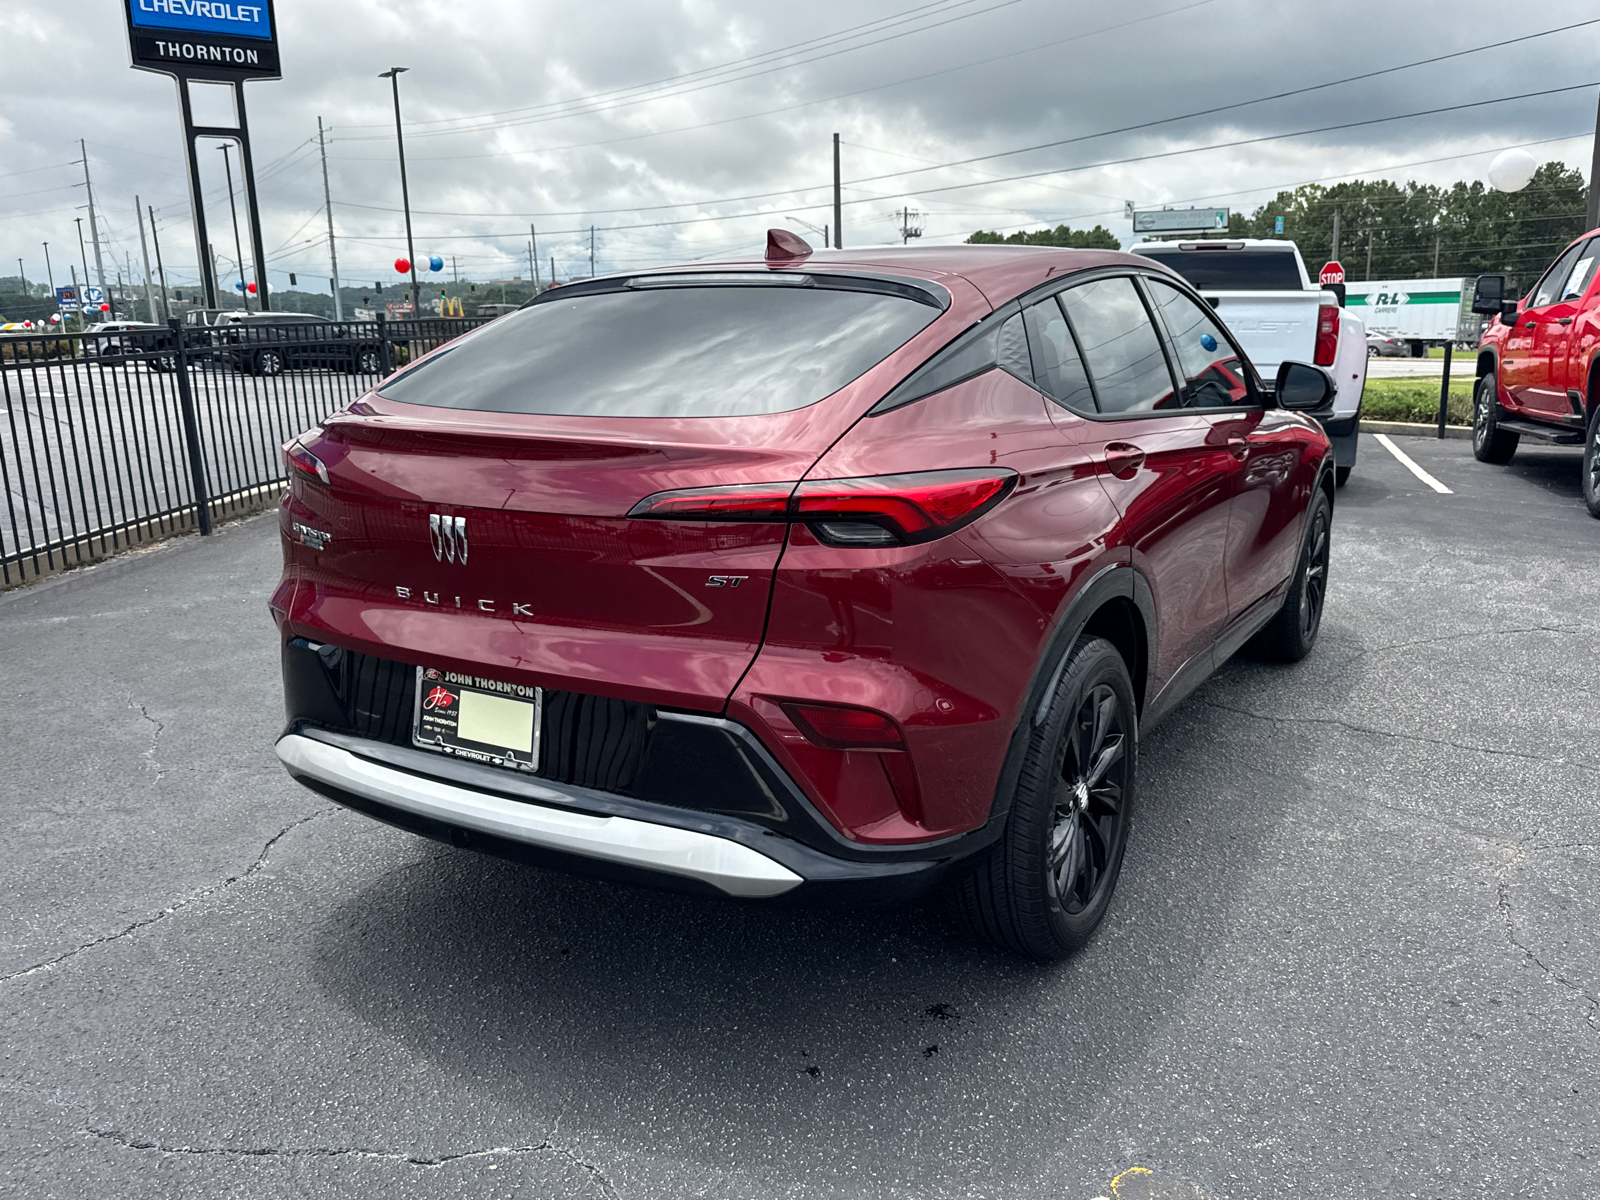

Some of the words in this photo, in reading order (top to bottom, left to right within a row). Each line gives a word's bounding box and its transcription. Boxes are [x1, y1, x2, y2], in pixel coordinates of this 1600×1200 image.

[139, 0, 261, 23] CHEVROLET
[155, 41, 259, 64] THORNTON
[1321, 273, 1343, 284] STOP
[1374, 306, 1398, 314] CARRIERS
[705, 575, 749, 587] ST
[395, 585, 534, 616] BUICK
[444, 671, 473, 686] JOHN
[474, 678, 534, 698] THORNTON
[423, 714, 435, 722] JOHN
[434, 716, 457, 727] THORNTON
[455, 749, 490, 761] CHEVROLET
